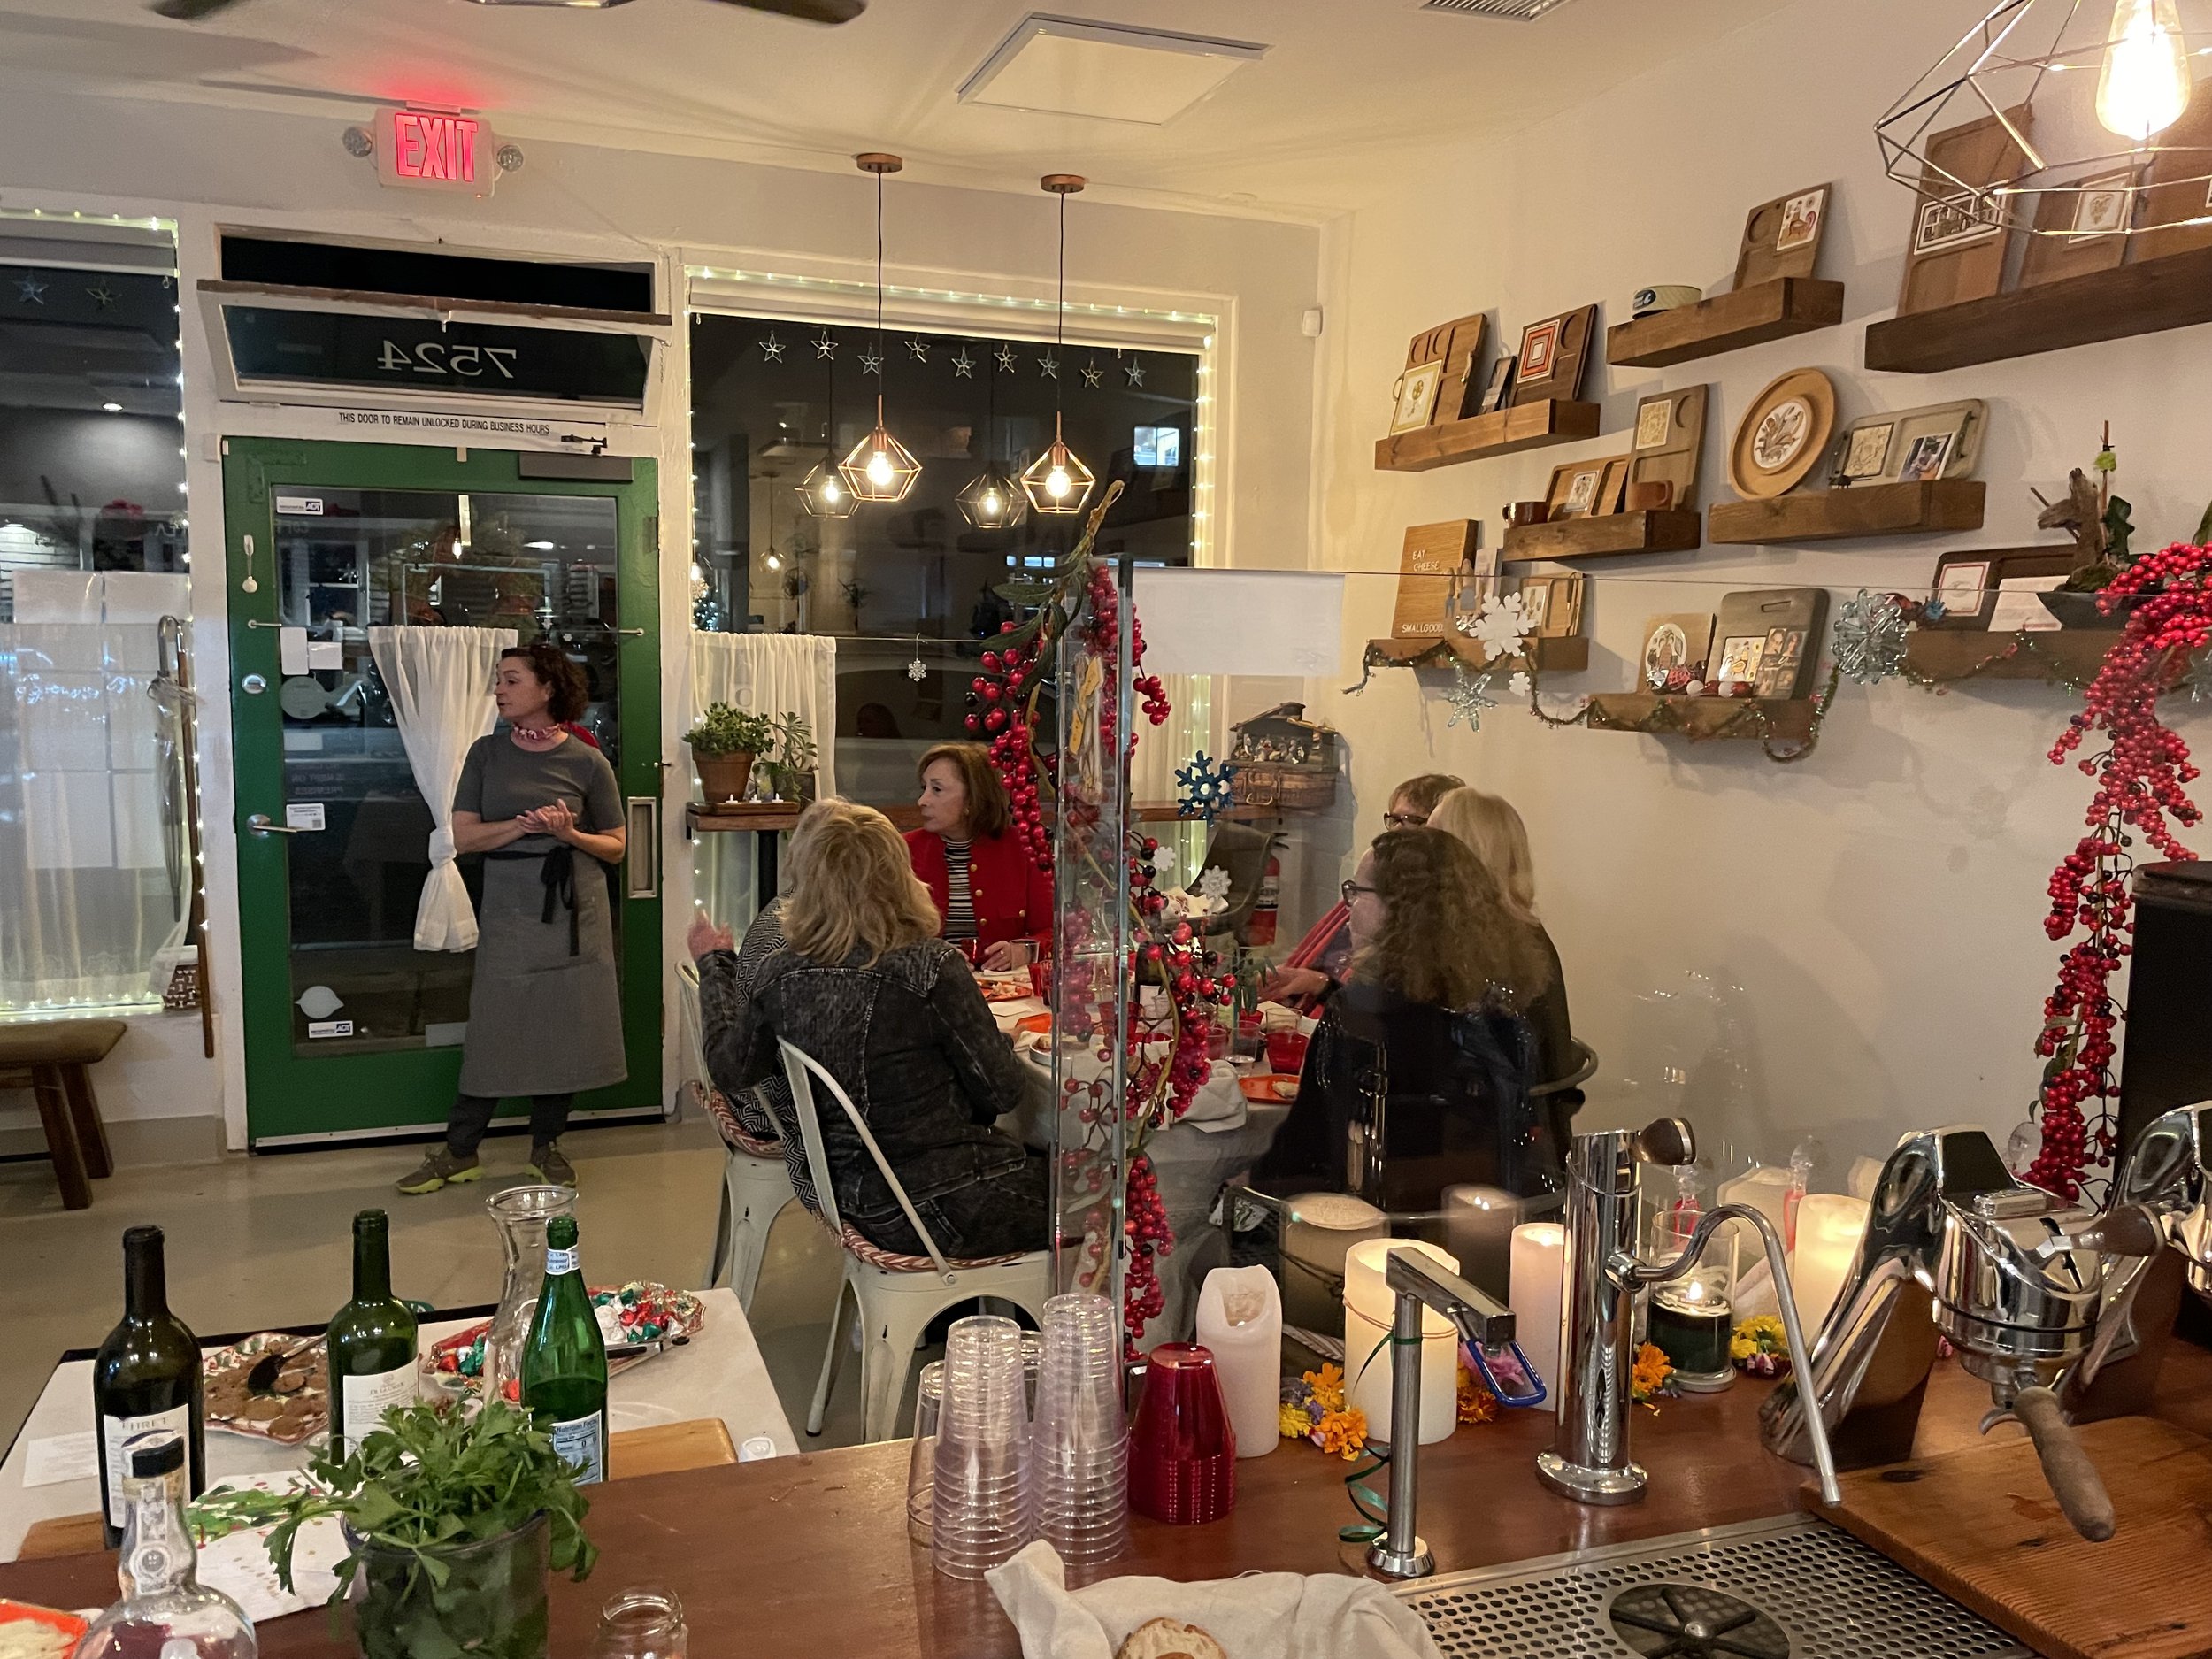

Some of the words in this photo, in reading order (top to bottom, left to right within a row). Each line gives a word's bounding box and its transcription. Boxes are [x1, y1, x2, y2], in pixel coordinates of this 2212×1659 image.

[395, 112, 478, 182] EXIT
[339, 412, 356, 423] THIS
[357, 413, 379, 424] DOOR
[381, 414, 391, 425] TO
[393, 415, 420, 426] REMAIN
[422, 417, 460, 428] UNLOCKED
[462, 419, 488, 430] DURING
[490, 421, 524, 433] BUSINESS
[526, 424, 550, 435] HOURS
[306, 502, 320, 511] ADT
[1412, 549, 1426, 560] EAT
[1413, 561, 1440, 572] CHEESE
[336, 1024, 350, 1033] ADT
